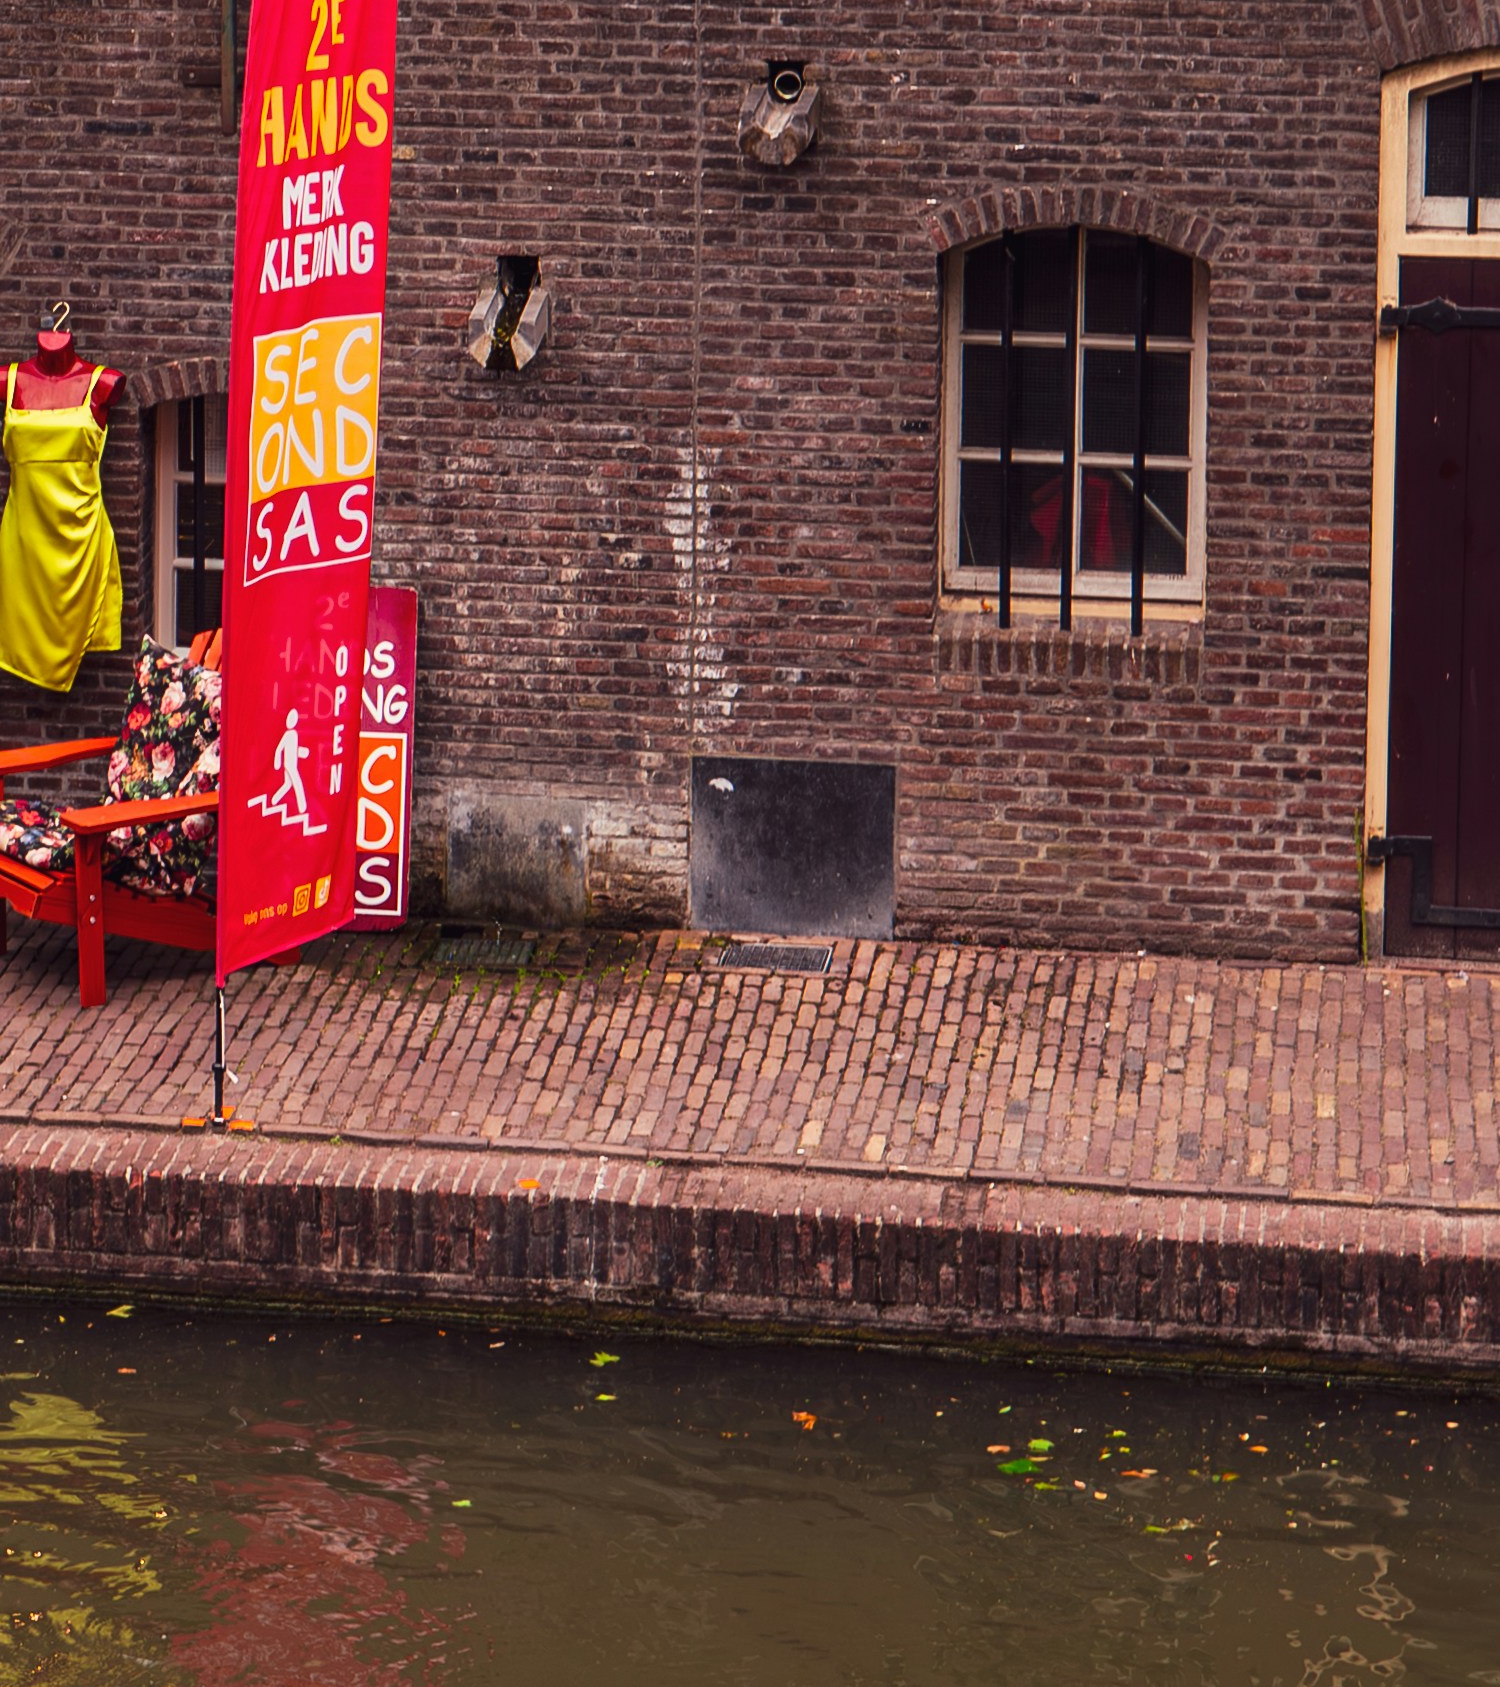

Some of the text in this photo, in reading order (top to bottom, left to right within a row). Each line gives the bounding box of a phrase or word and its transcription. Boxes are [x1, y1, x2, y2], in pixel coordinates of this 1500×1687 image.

[257, 68, 389, 168] HANDS
[283, 164, 344, 230] MERK
[260, 221, 375, 294] KLEDING
[261, 325, 372, 415] SEC
[256, 405, 374, 493] OND
[253, 484, 368, 571] SAS
[330, 645, 348, 795] OPEN
